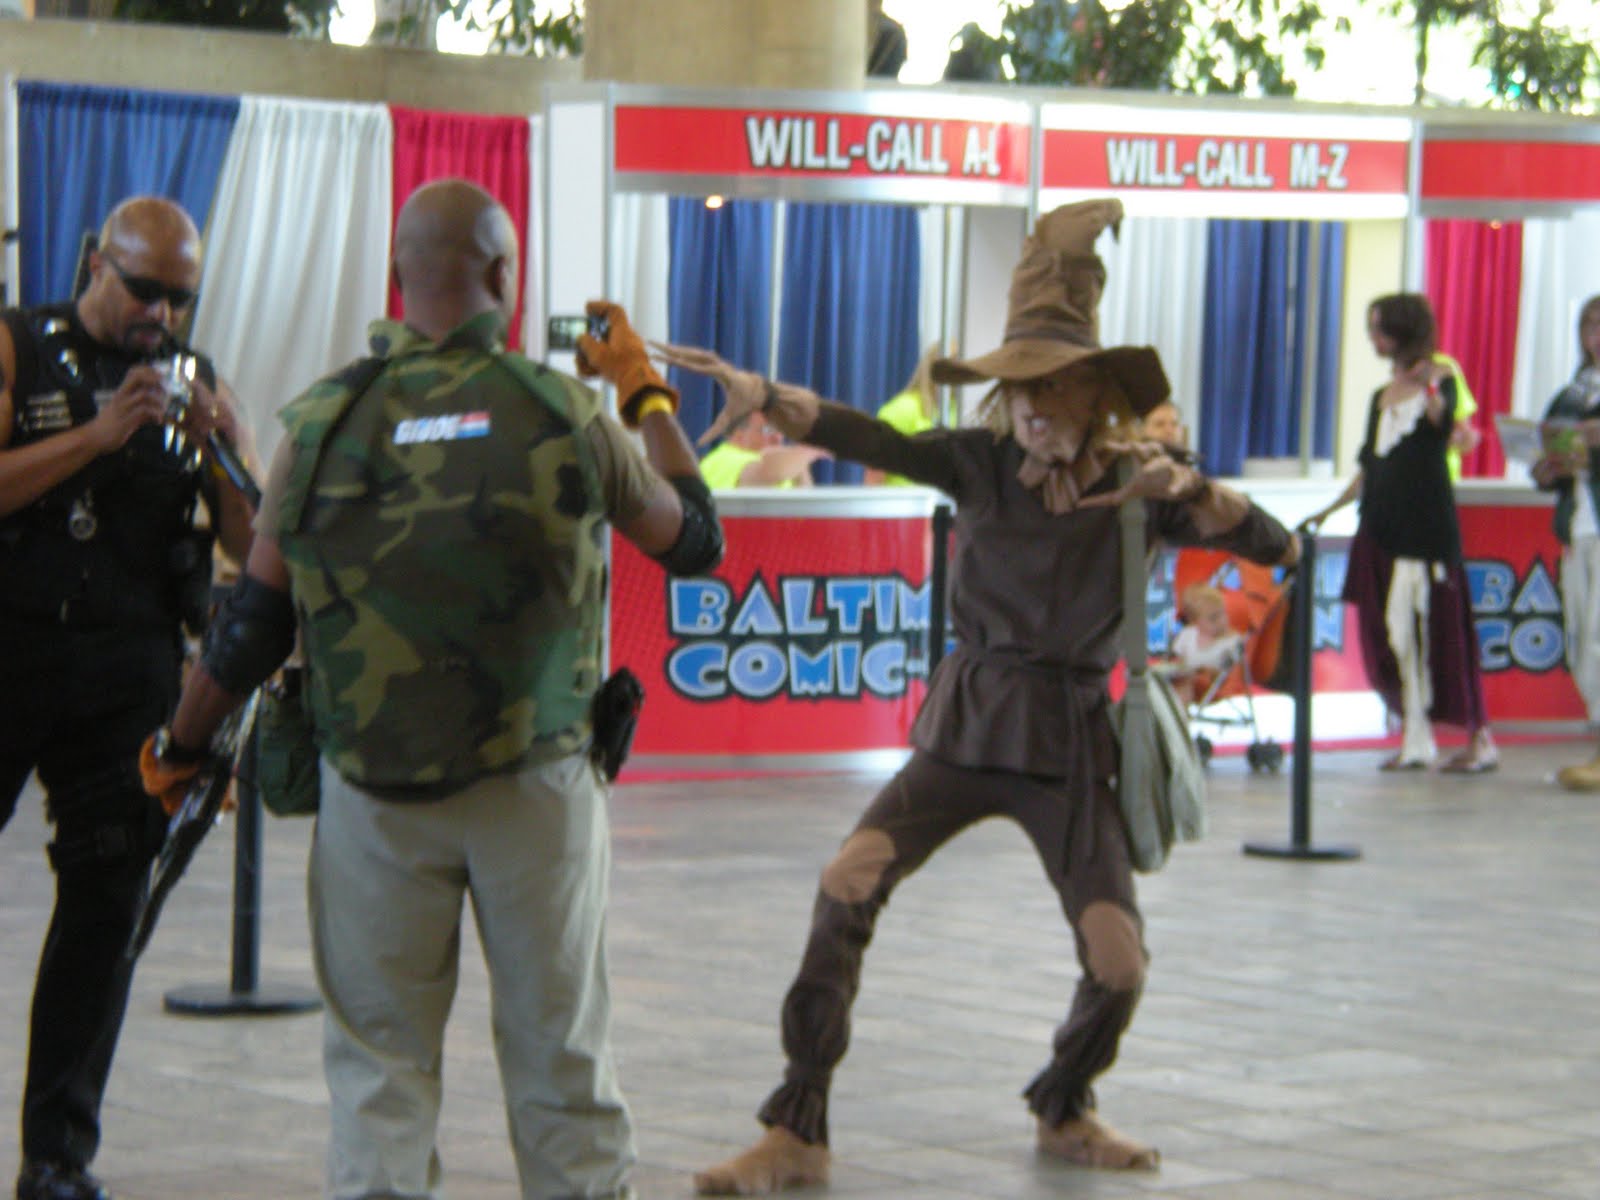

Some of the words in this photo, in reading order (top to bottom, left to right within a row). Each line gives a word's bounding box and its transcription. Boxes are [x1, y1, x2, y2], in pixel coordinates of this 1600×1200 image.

[745, 116, 950, 175] WILL-CALL
[962, 124, 1002, 177] A-L
[1105, 137, 1274, 189] WILL-CALL
[1289, 142, 1349, 190] M-Z
[669, 576, 930, 636] BALTIM
[1463, 560, 1563, 615] BA
[668, 638, 930, 698] COMIC-
[1474, 617, 1566, 671] CO
